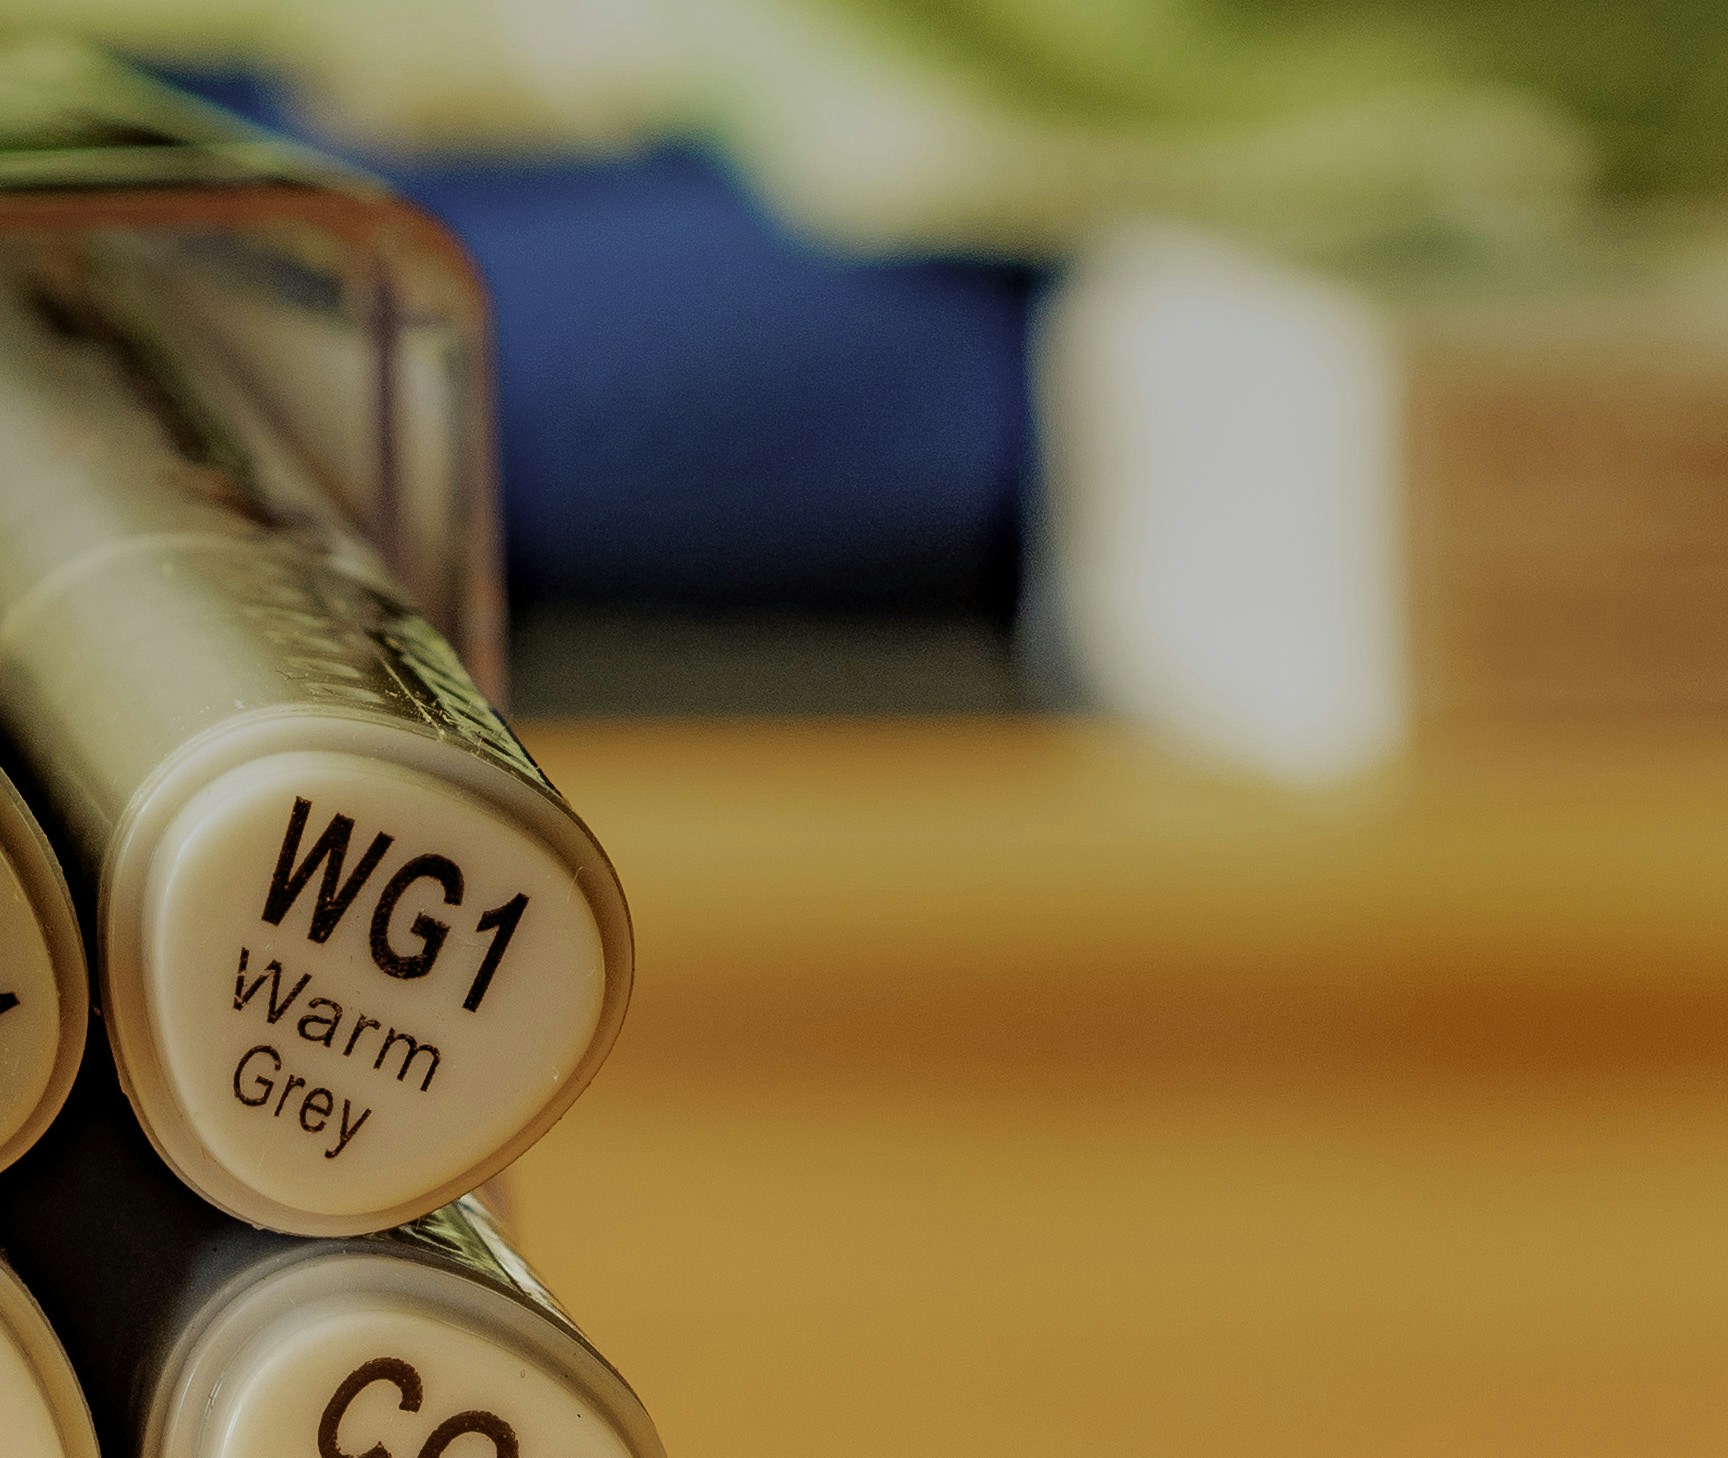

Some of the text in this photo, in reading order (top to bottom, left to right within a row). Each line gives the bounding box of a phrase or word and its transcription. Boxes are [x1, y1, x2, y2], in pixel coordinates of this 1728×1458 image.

[261, 795, 529, 1013] WG1
[232, 947, 440, 1093] Warm
[233, 1045, 372, 1159] Grey
